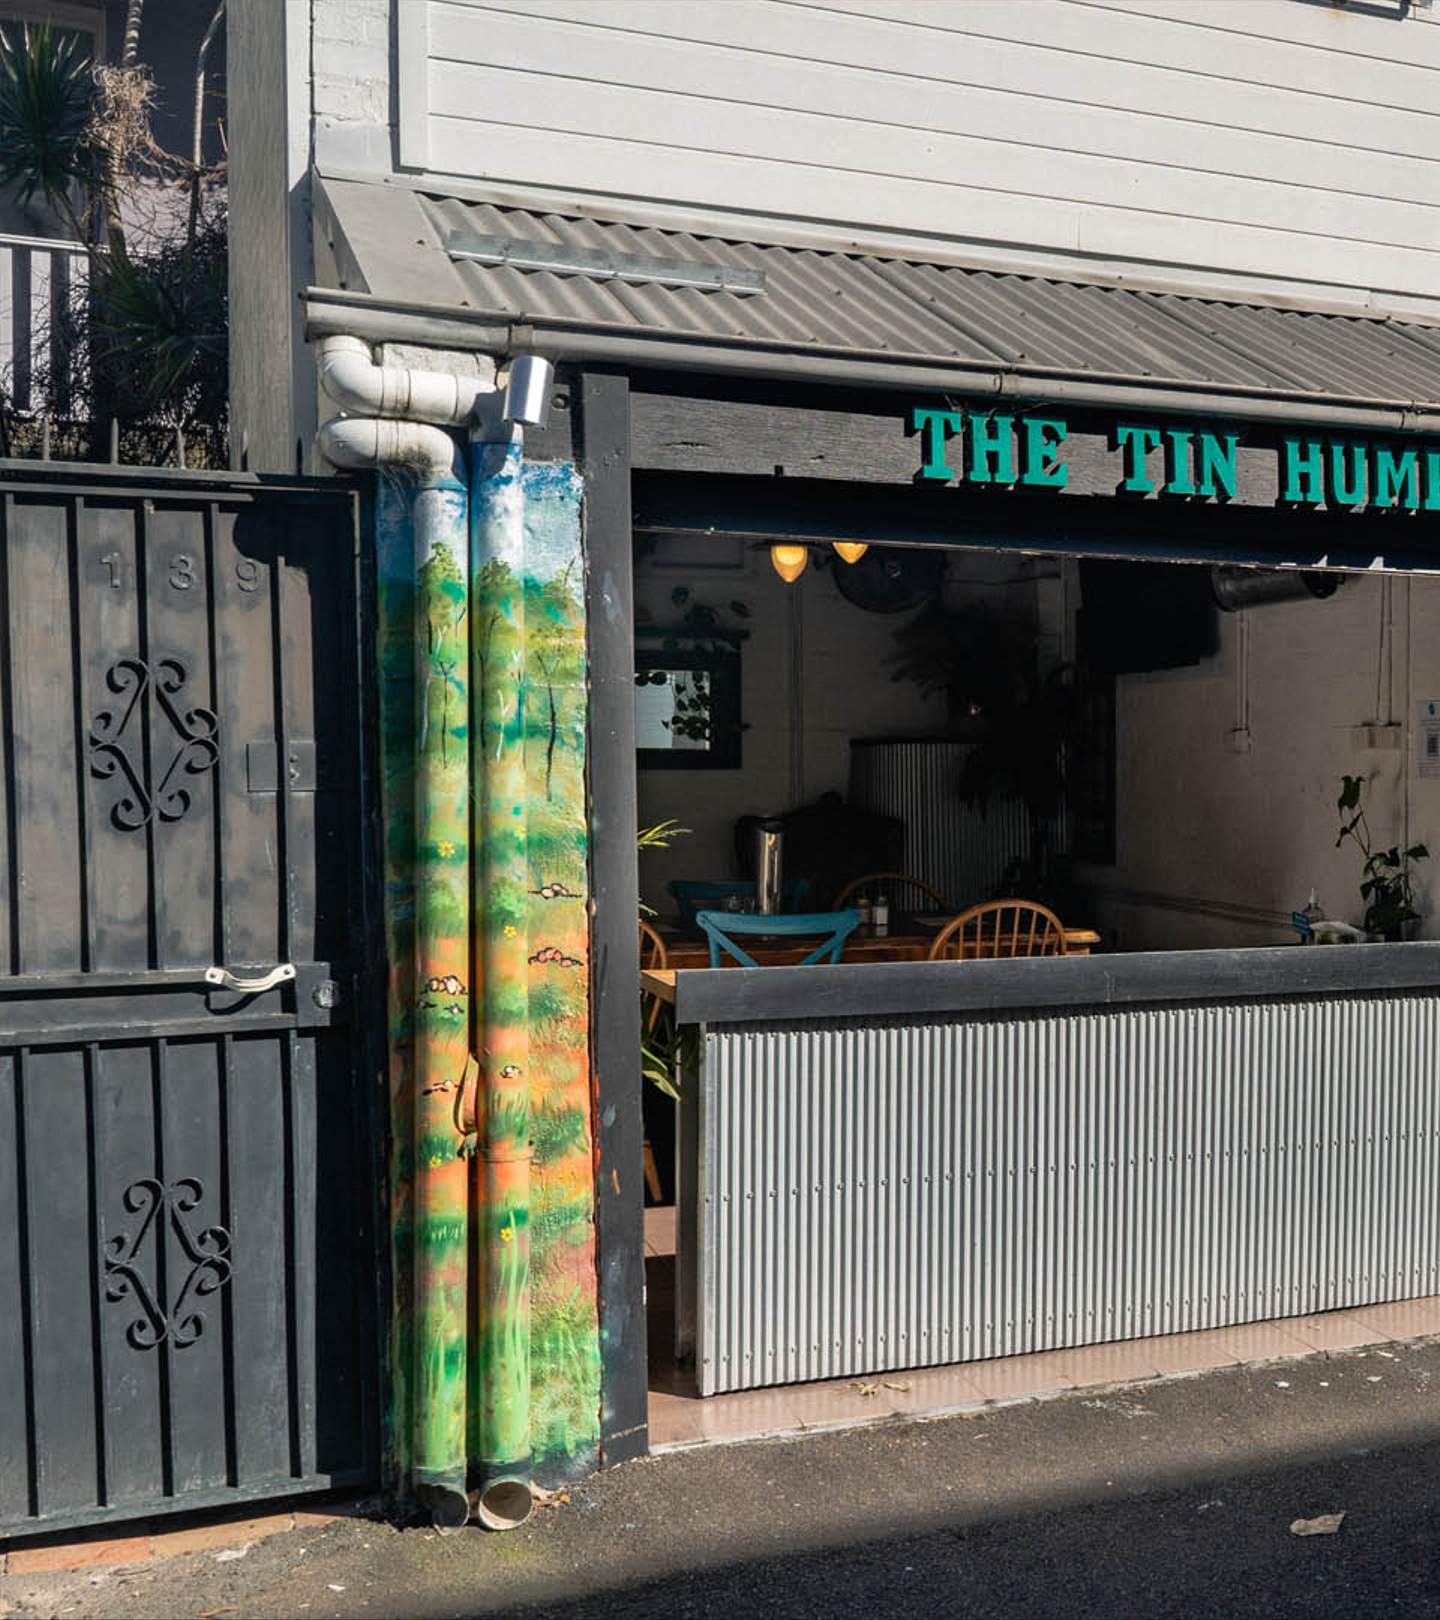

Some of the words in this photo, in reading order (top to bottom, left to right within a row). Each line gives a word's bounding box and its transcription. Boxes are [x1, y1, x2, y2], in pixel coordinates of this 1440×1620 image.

[914, 408, 1068, 487] THE
[1117, 425, 1239, 497] TIN
[100, 552, 258, 592] 139
